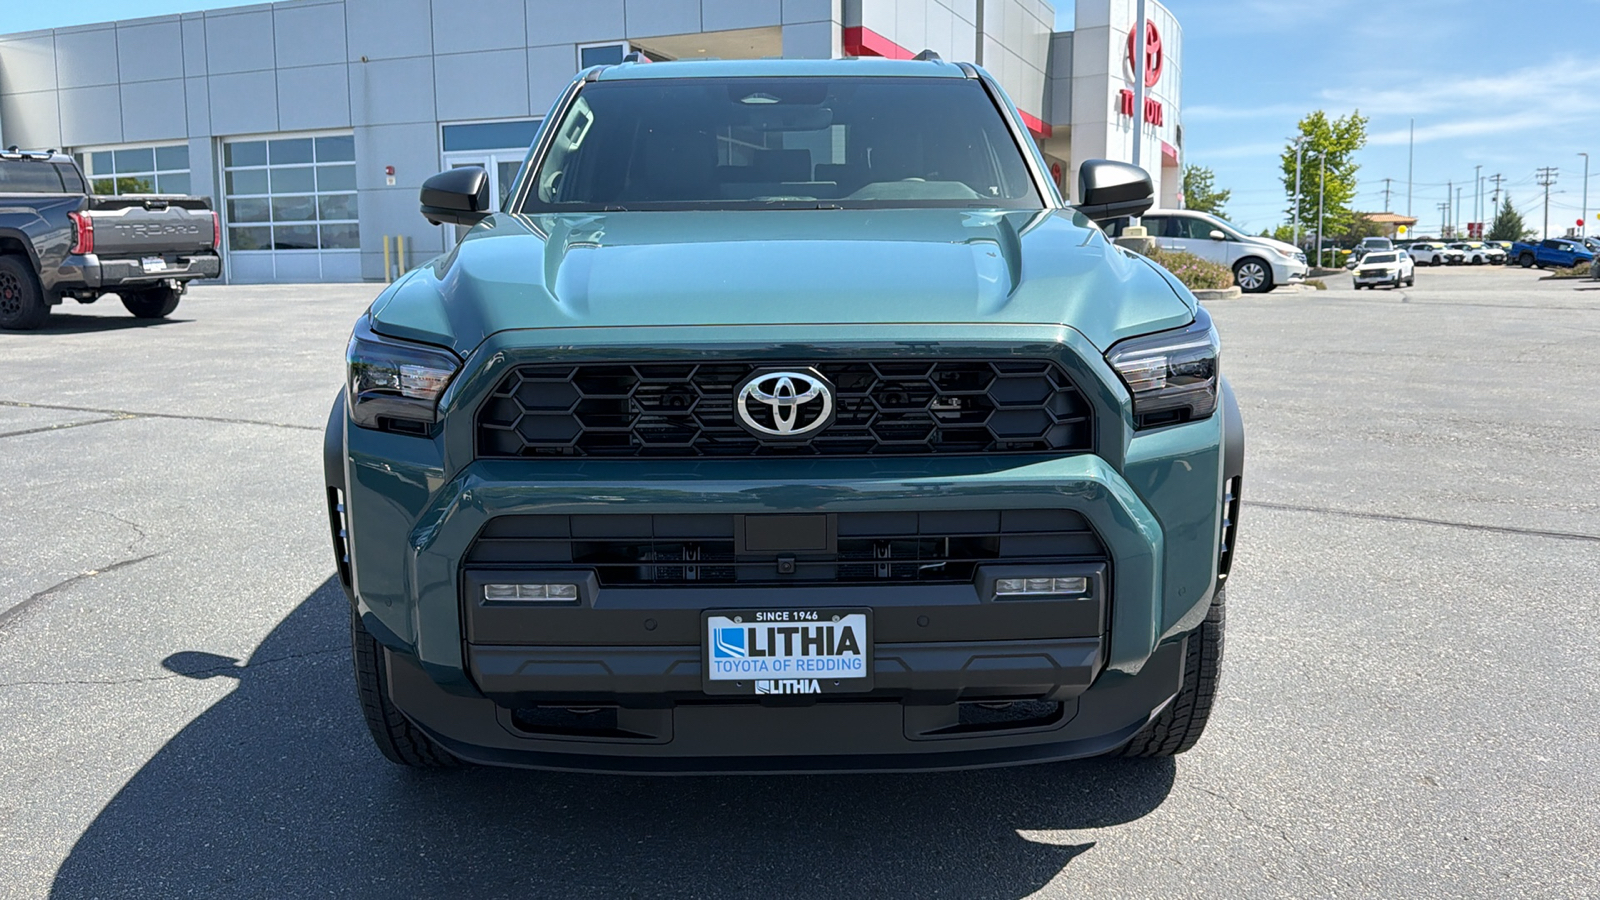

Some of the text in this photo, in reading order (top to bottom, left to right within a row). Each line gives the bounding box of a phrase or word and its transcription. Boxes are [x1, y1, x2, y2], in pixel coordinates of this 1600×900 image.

[1119, 89, 1163, 127] TOTA
[756, 611, 819, 621] SINCE 1946
[748, 626, 861, 657] LITHIA
[714, 657, 862, 673] TOYOTA OF REDDING
[769, 679, 822, 694] LITHIA
